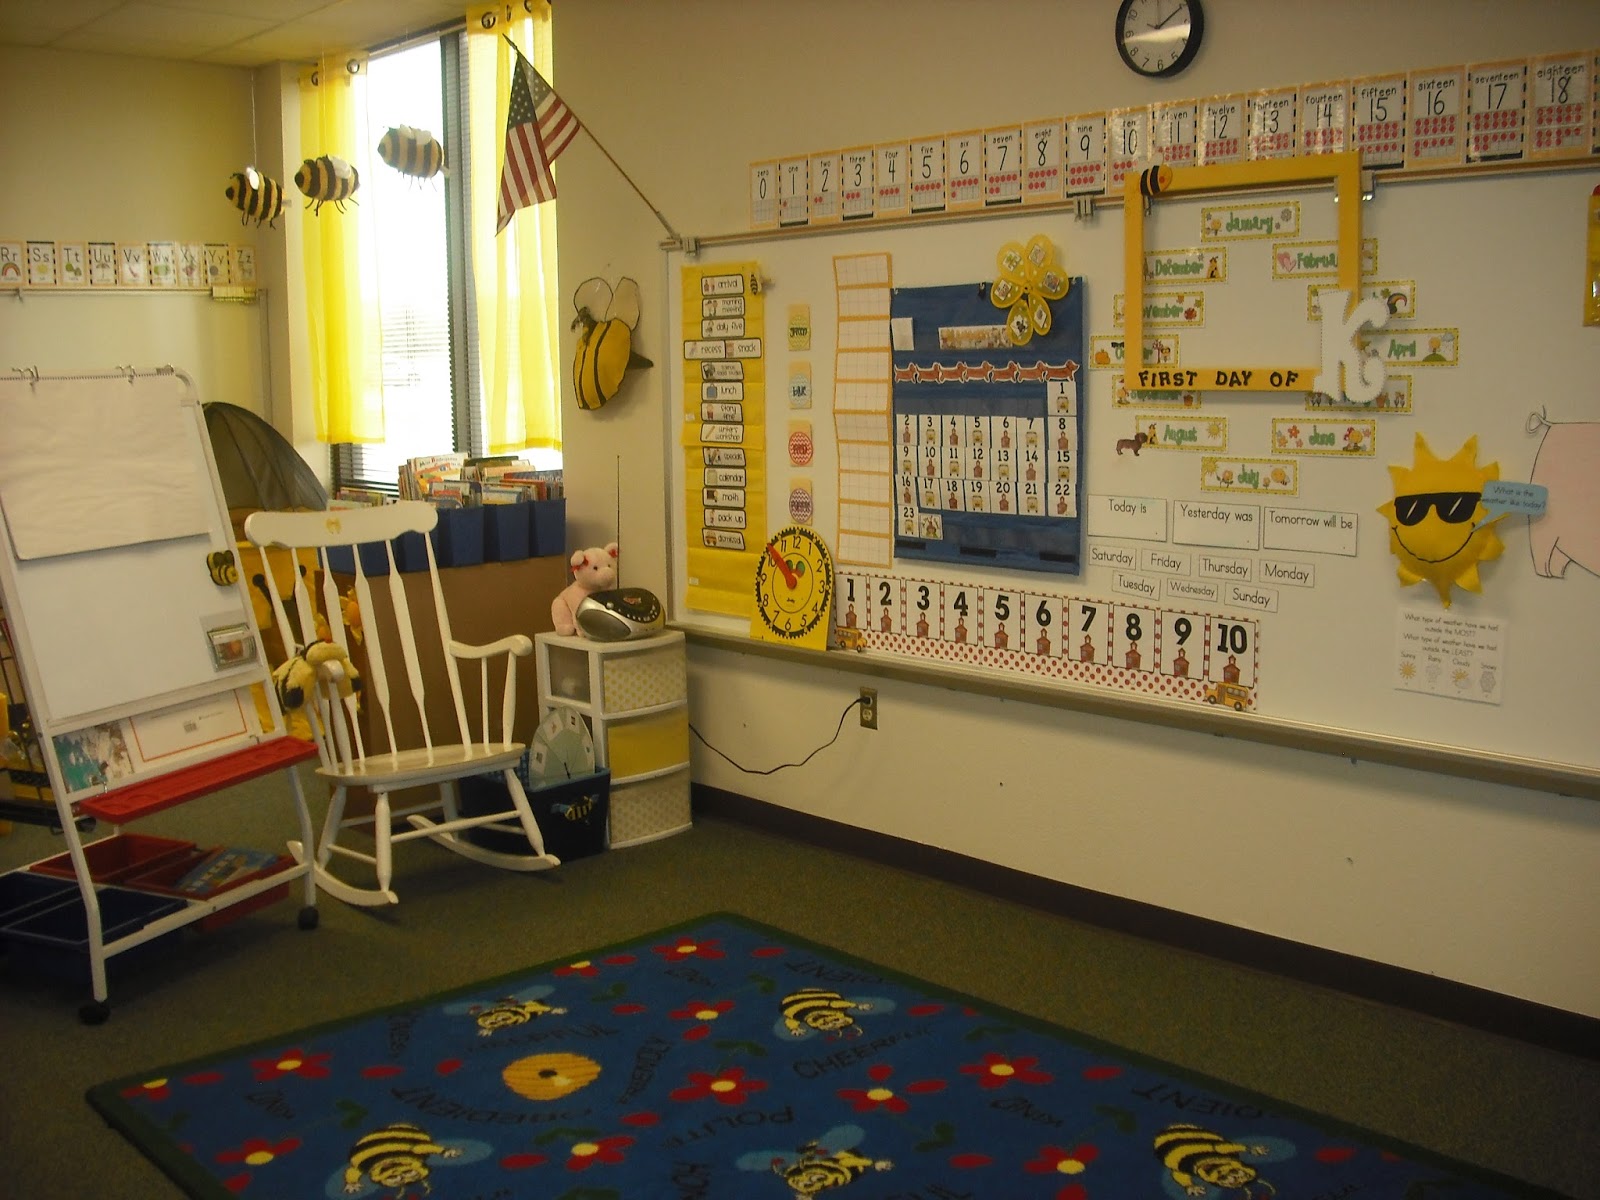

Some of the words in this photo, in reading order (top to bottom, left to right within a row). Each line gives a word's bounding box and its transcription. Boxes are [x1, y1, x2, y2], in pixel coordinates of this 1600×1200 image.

[1142, 57, 1150, 67] 7
[1170, 51, 1179, 60] 5
[1157, 58, 1164, 71] 6
[1536, 64, 1585, 80] eighteen
[1417, 78, 1455, 91] sixteen
[1474, 71, 1519, 84] seventeen
[1361, 86, 1397, 99] fifteen
[1488, 83, 1507, 110] 17
[1551, 76, 1572, 104] 18
[1252, 98, 1289, 110] thirteen
[1305, 93, 1343, 104] fourteen
[1427, 89, 1445, 116] 16
[1207, 105, 1236, 117] twelve
[1316, 103, 1333, 128] 14
[1370, 97, 1388, 122] 15
[1077, 125, 1093, 133] nine
[1122, 119, 1136, 127] ten
[1213, 114, 1228, 139] 12
[1262, 110, 1279, 134] 13
[992, 134, 1013, 144] seven
[1034, 128, 1052, 140] eight
[1170, 120, 1180, 143] 11
[920, 145, 934, 154] five
[960, 140, 969, 148] six
[1080, 134, 1090, 160] 9
[1123, 128, 1138, 156] 10
[849, 155, 866, 163] three
[884, 150, 899, 159] four
[997, 145, 1008, 171] 7
[1037, 140, 1048, 167] 8
[921, 155, 932, 179] 5
[960, 149, 969, 175] 6
[854, 163, 862, 187] 3
[888, 160, 896, 183] 4
[792, 174, 796, 195] 1
[821, 168, 829, 192] 2
[760, 178, 767, 199] 0
[1225, 211, 1274, 234] January
[1296, 252, 1338, 270] Februa
[718, 279, 738, 288] arrival
[716, 323, 729, 333] daily
[701, 345, 722, 354] recess
[737, 343, 756, 352] snack
[1138, 370, 1198, 388] FIRST
[1215, 370, 1253, 388] DAY
[1269, 370, 1299, 387] OF
[1313, 290, 1390, 403] K
[720, 386, 737, 395] lunch
[1059, 383, 1065, 394] 1
[904, 414, 910, 426] 2
[927, 416, 933, 427] 3
[950, 416, 957, 427] 4
[974, 416, 980, 428] 5
[1002, 416, 1009, 428] 6
[1026, 417, 1034, 430] 7
[1058, 417, 1066, 430] 8
[1163, 424, 1198, 445] August
[903, 446, 909, 457] 9
[925, 446, 936, 458] 10
[949, 447, 959, 459] 11
[973, 448, 984, 460] 12
[997, 449, 1009, 461] 13
[1026, 449, 1039, 462] 14
[1057, 450, 1070, 463] 15
[719, 472, 743, 482] calendar
[901, 475, 911, 487] 16
[923, 478, 934, 489] 17
[946, 480, 958, 492] 18
[971, 481, 982, 493] 19
[996, 482, 1010, 493] 20
[1025, 483, 1037, 495] 21
[1054, 483, 1071, 496] 22
[722, 493, 739, 502] math
[903, 507, 914, 518] 23
[1108, 498, 1137, 516] Today
[1140, 503, 1147, 513] is
[1180, 503, 1231, 524] Yesterday
[1234, 511, 1253, 522] was
[718, 514, 732, 522] pack
[1269, 510, 1320, 526] Tomorrow
[1323, 514, 1337, 528] will
[1340, 516, 1353, 530] be
[781, 539, 787, 553] 11
[792, 535, 802, 549] 12
[808, 542, 812, 555] 1
[1091, 547, 1134, 567] Saturday
[1150, 552, 1182, 572] Friday
[816, 559, 823, 572] 2
[1202, 557, 1249, 578] Thursday
[760, 573, 768, 586] 9
[1264, 563, 1310, 584] Monday
[818, 580, 825, 593] 3
[1118, 574, 1156, 596] Tuesday
[1169, 581, 1215, 598] Wednesday
[762, 594, 769, 607] 8
[1232, 587, 1271, 608] Sunday
[812, 602, 818, 613] 4
[773, 610, 780, 622] 7
[800, 614, 807, 627] 5
[846, 578, 855, 602] 1
[879, 581, 892, 606] 2
[916, 585, 930, 611] 3
[953, 591, 969, 617] 4
[994, 594, 1010, 621] 5
[1036, 600, 1052, 627] 6
[1081, 605, 1097, 632] 7
[1125, 612, 1142, 641] 8
[1174, 617, 1192, 646] 9
[1217, 623, 1248, 655] 10
[784, 618, 791, 631] 6
